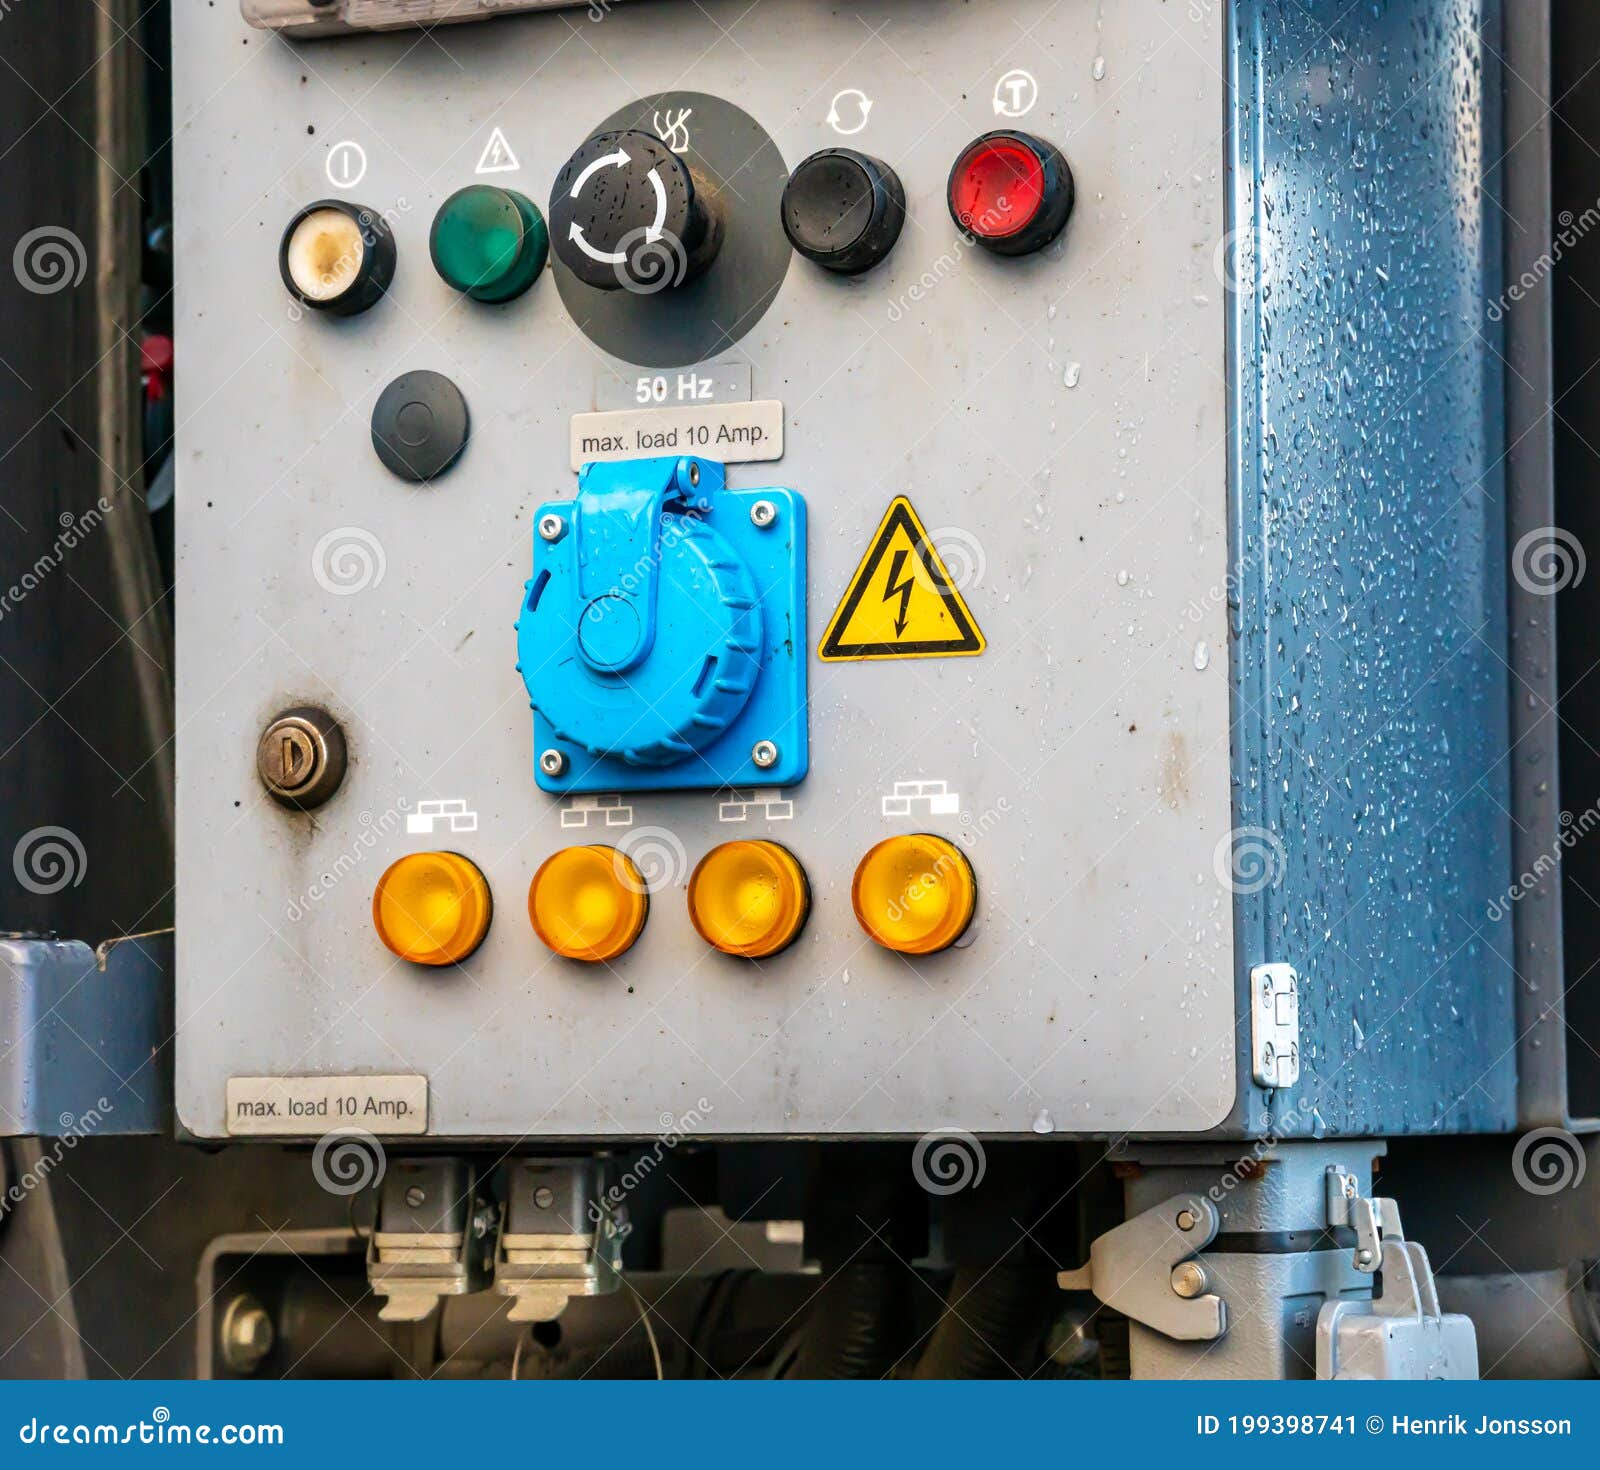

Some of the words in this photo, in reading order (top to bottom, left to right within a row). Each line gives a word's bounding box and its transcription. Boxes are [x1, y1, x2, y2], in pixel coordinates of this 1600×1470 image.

[1005, 79, 1027, 110] T
[636, 376, 668, 403] 50
[677, 373, 713, 400] Hz
[582, 434, 629, 453] max.
[637, 428, 678, 449] load
[687, 425, 709, 445] 10
[716, 424, 768, 447] Amp.
[237, 1101, 281, 1116] max.
[288, 1097, 328, 1115] load
[336, 1097, 357, 1115] 10
[363, 1096, 414, 1119] Amp.
